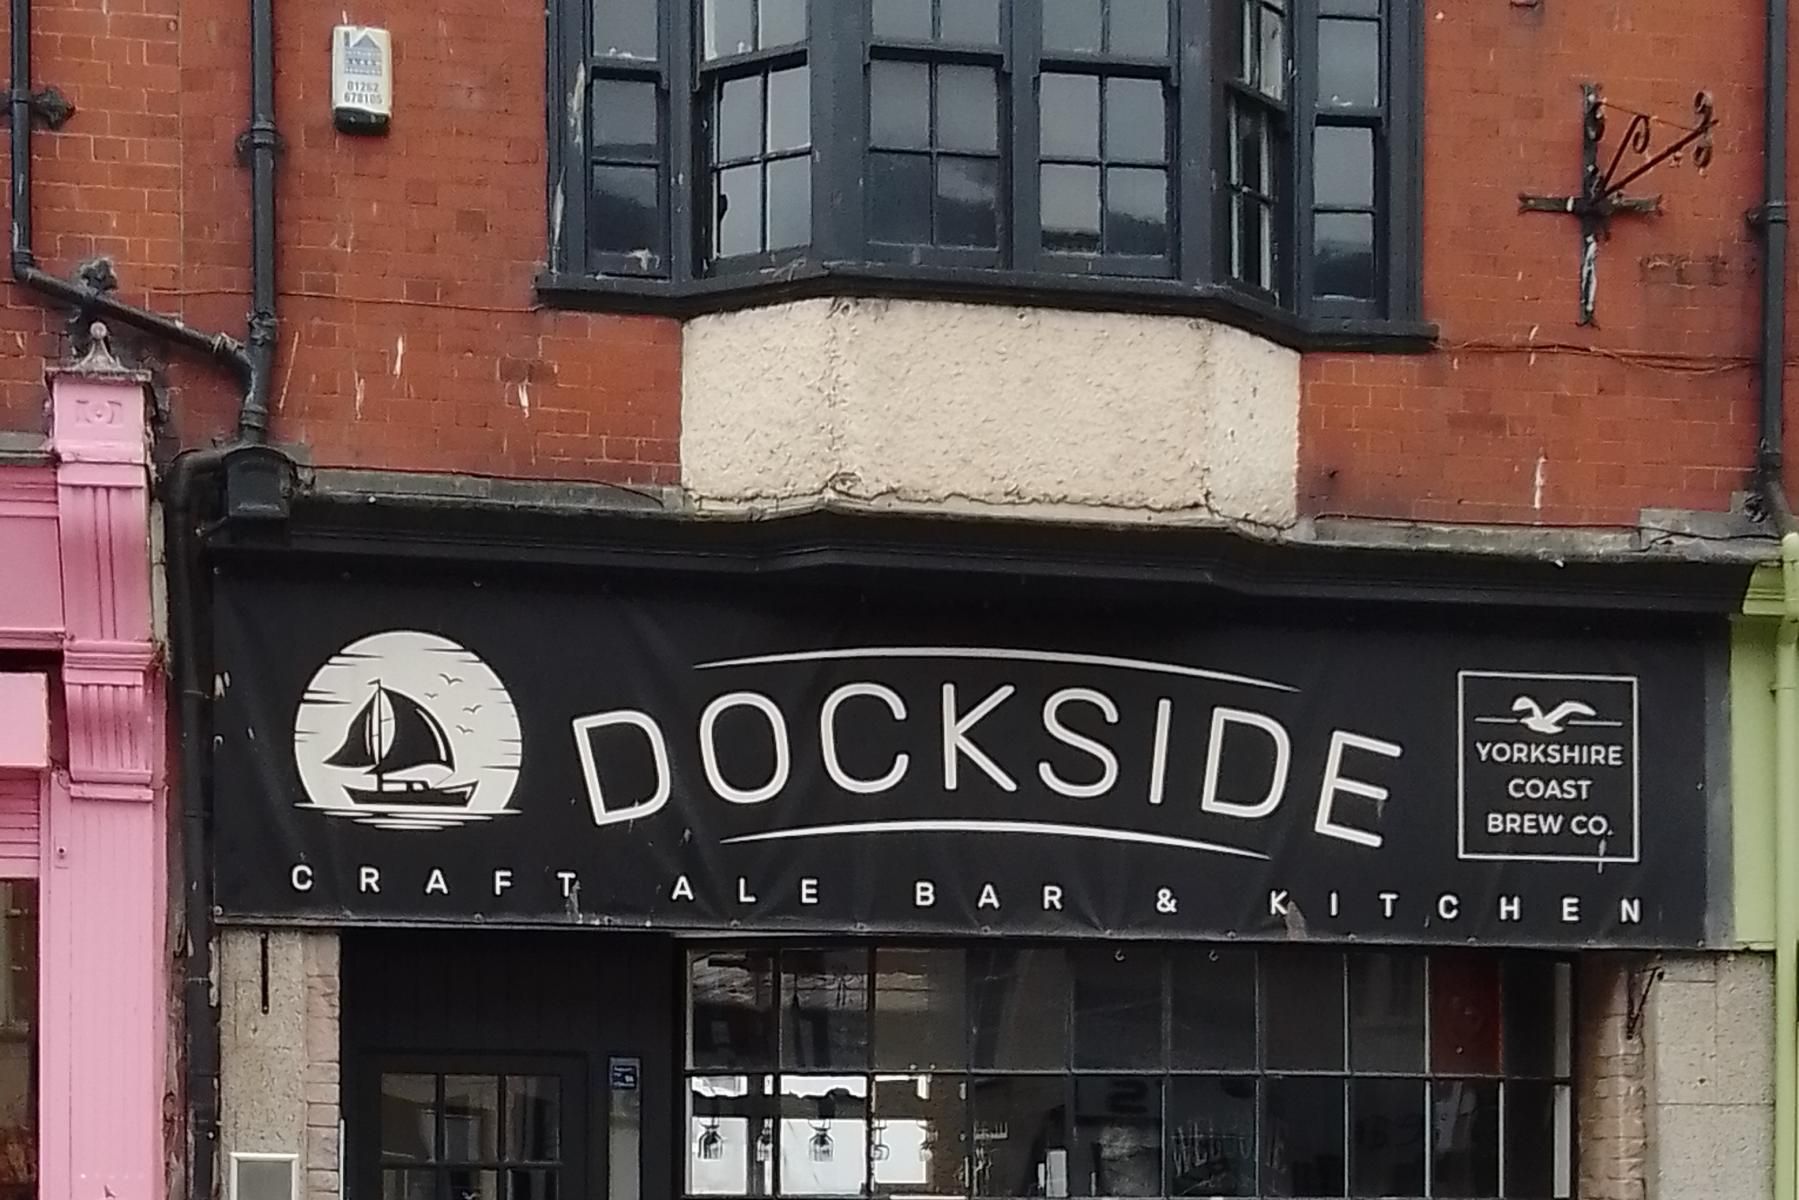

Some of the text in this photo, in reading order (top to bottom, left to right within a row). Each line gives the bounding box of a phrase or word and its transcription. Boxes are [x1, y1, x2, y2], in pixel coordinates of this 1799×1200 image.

[572, 681, 1403, 849] DOCKSIDE
[1475, 742, 1623, 766] YORKSHIRE
[1508, 778, 1592, 800] COAST
[1487, 813, 1564, 834] BREW
[291, 864, 1641, 923] CRAFT ALE BAR & KITCHEN
